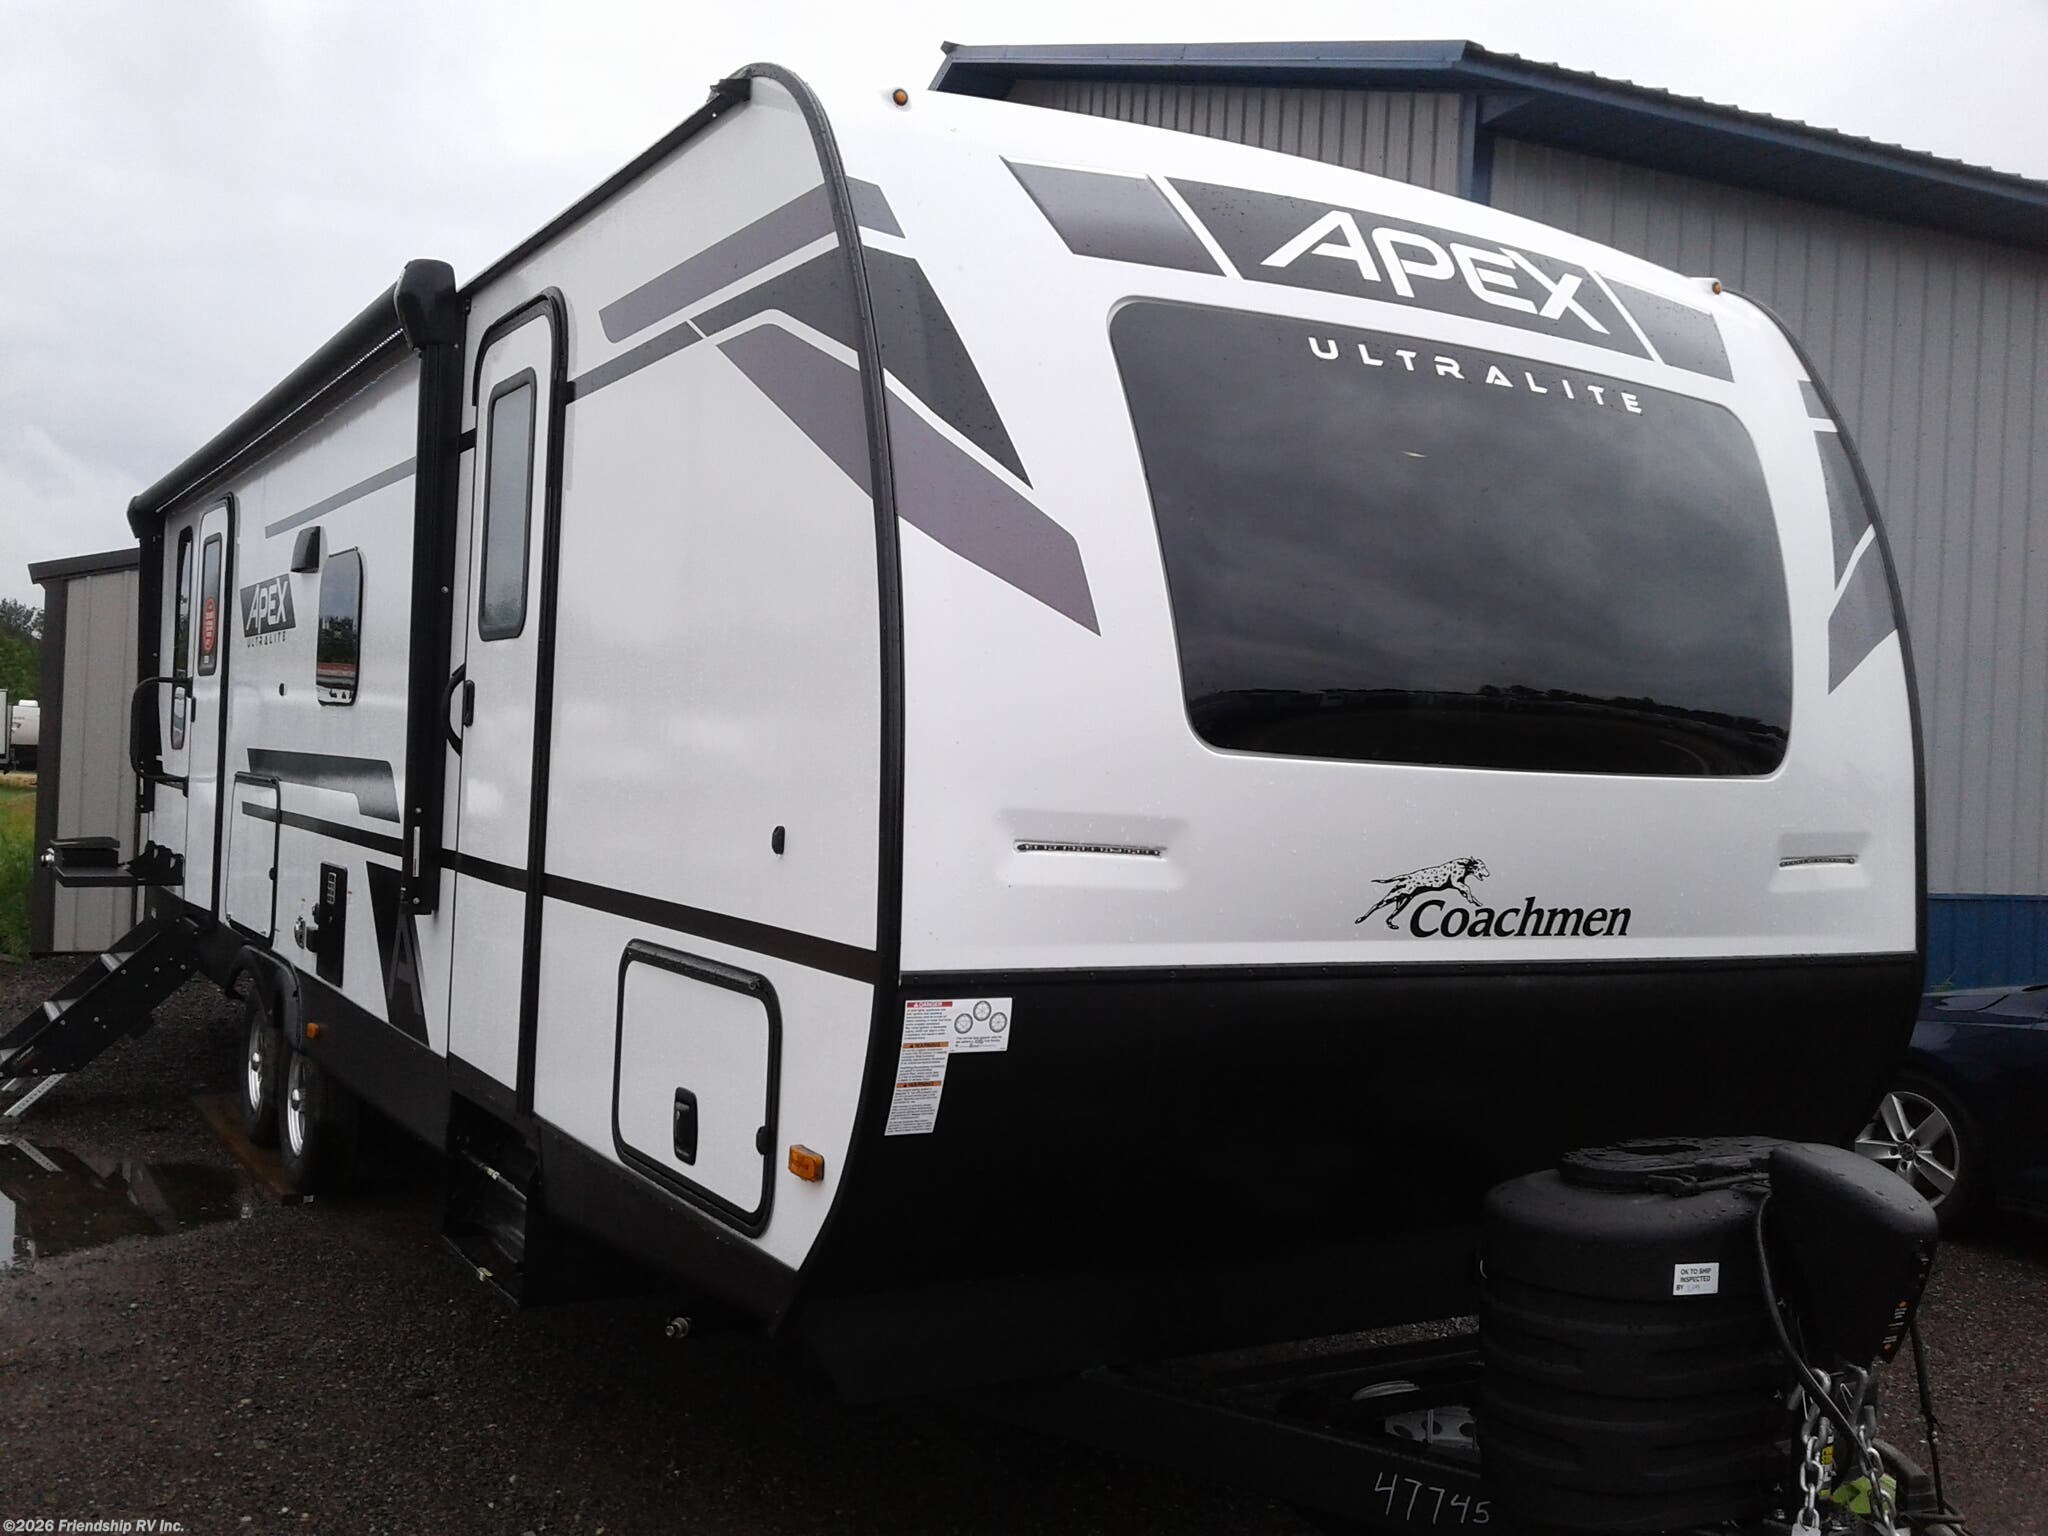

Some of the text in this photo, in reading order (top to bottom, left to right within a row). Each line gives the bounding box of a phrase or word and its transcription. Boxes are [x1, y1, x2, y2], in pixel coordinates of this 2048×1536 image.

[1260, 210, 1610, 334] APEX
[1308, 337, 1642, 414] ULTRALITE
[246, 578, 288, 633] APEX
[1410, 896, 1631, 938] Coachmen
[1374, 1471, 1491, 1525] 47745
